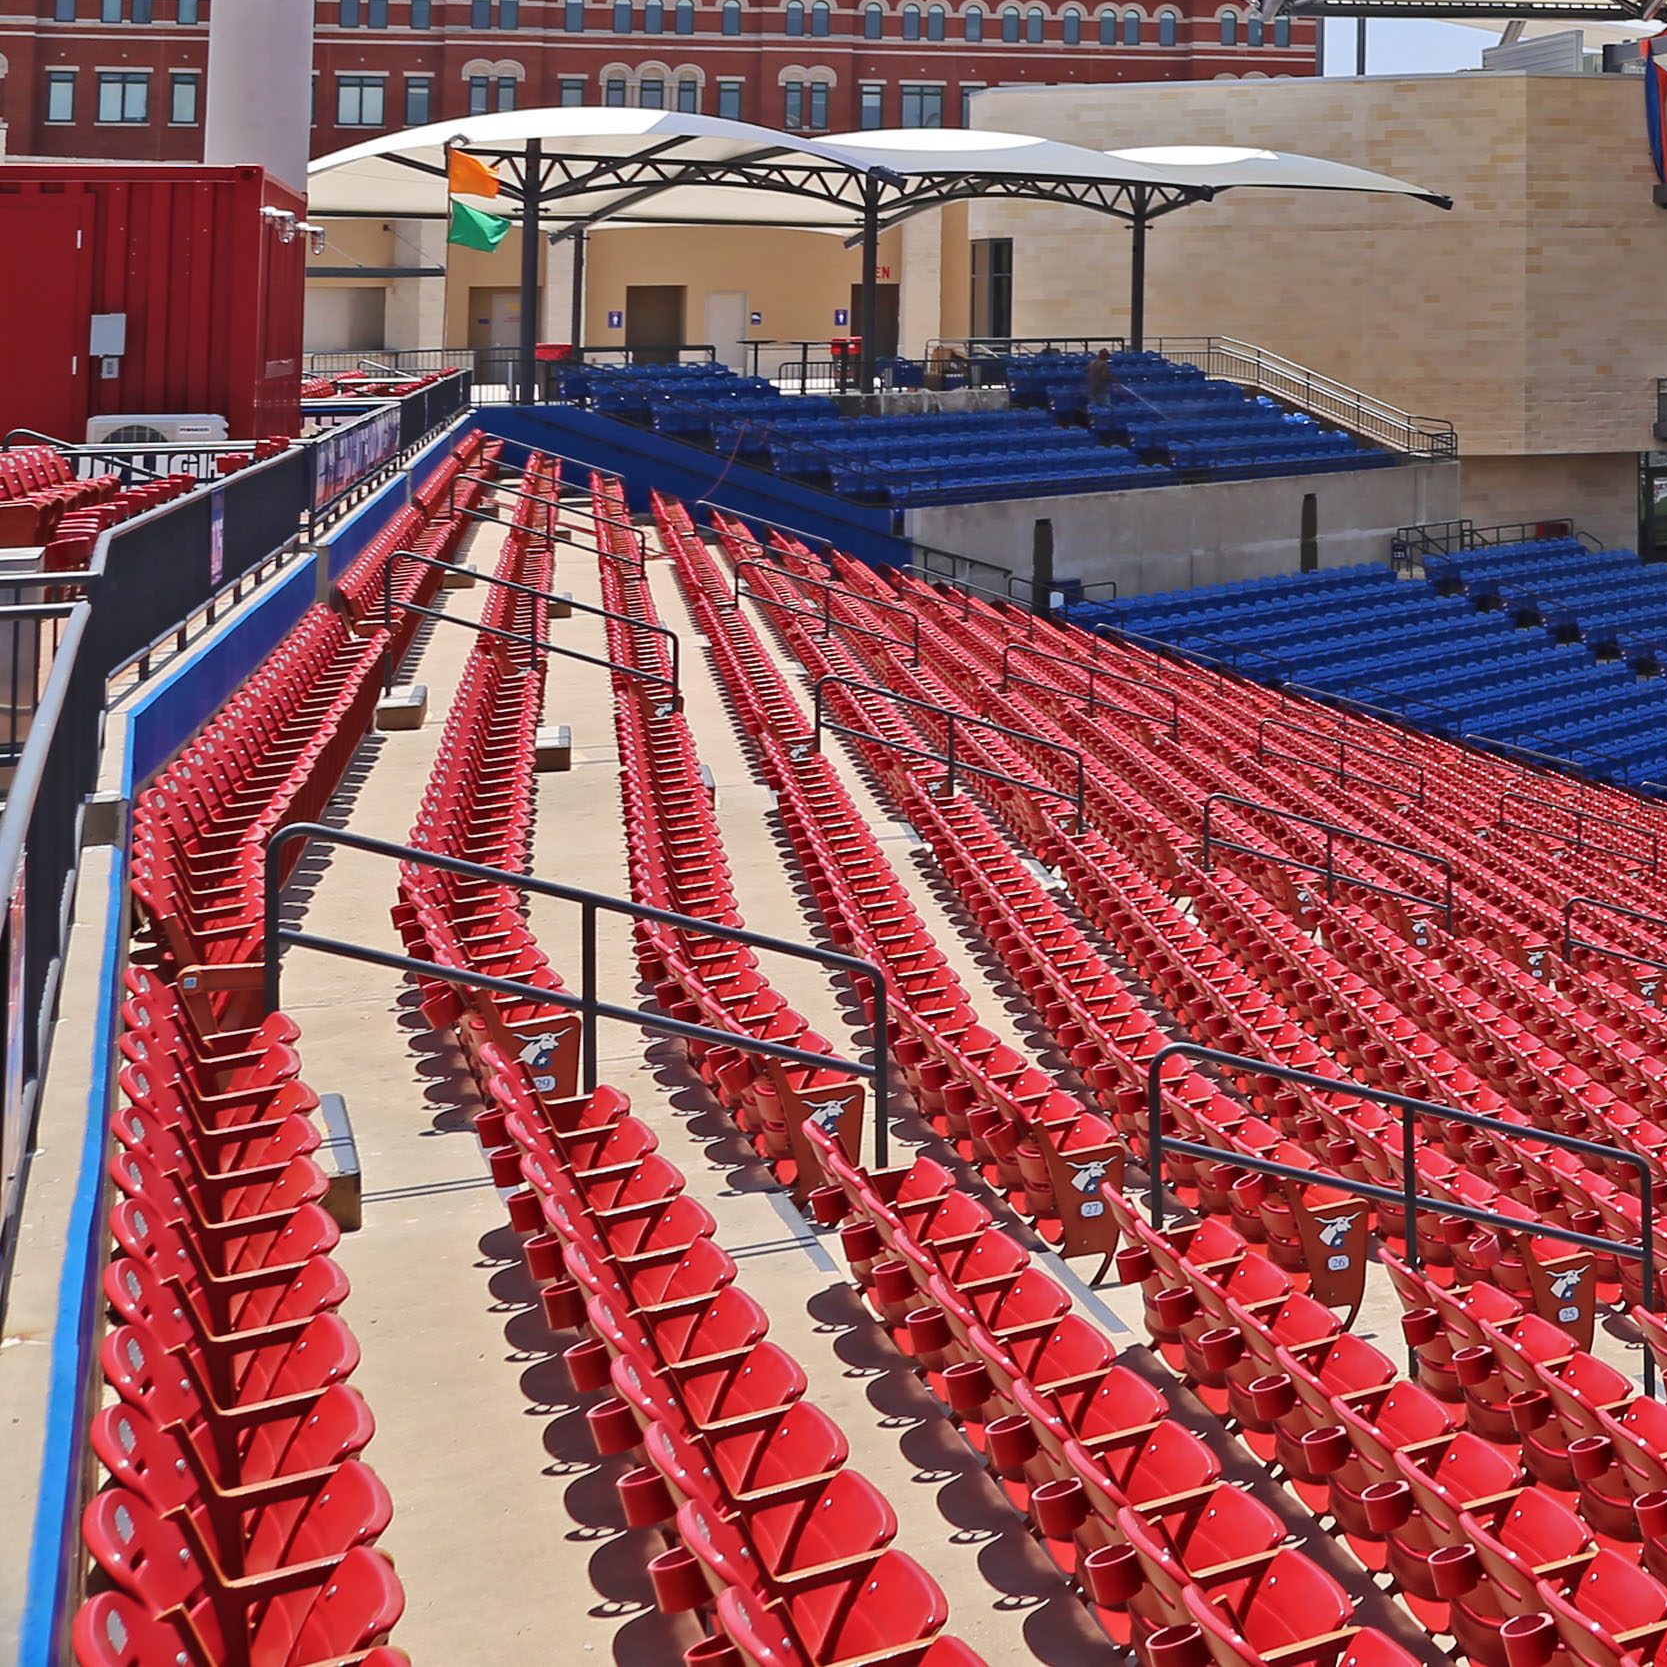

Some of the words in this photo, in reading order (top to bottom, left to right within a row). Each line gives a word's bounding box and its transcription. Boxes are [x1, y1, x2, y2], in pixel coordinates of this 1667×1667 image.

[1086, 1203, 1099, 1214] 27
[1332, 1258, 1345, 1268] 26
[1562, 1309, 1575, 1320] 25
